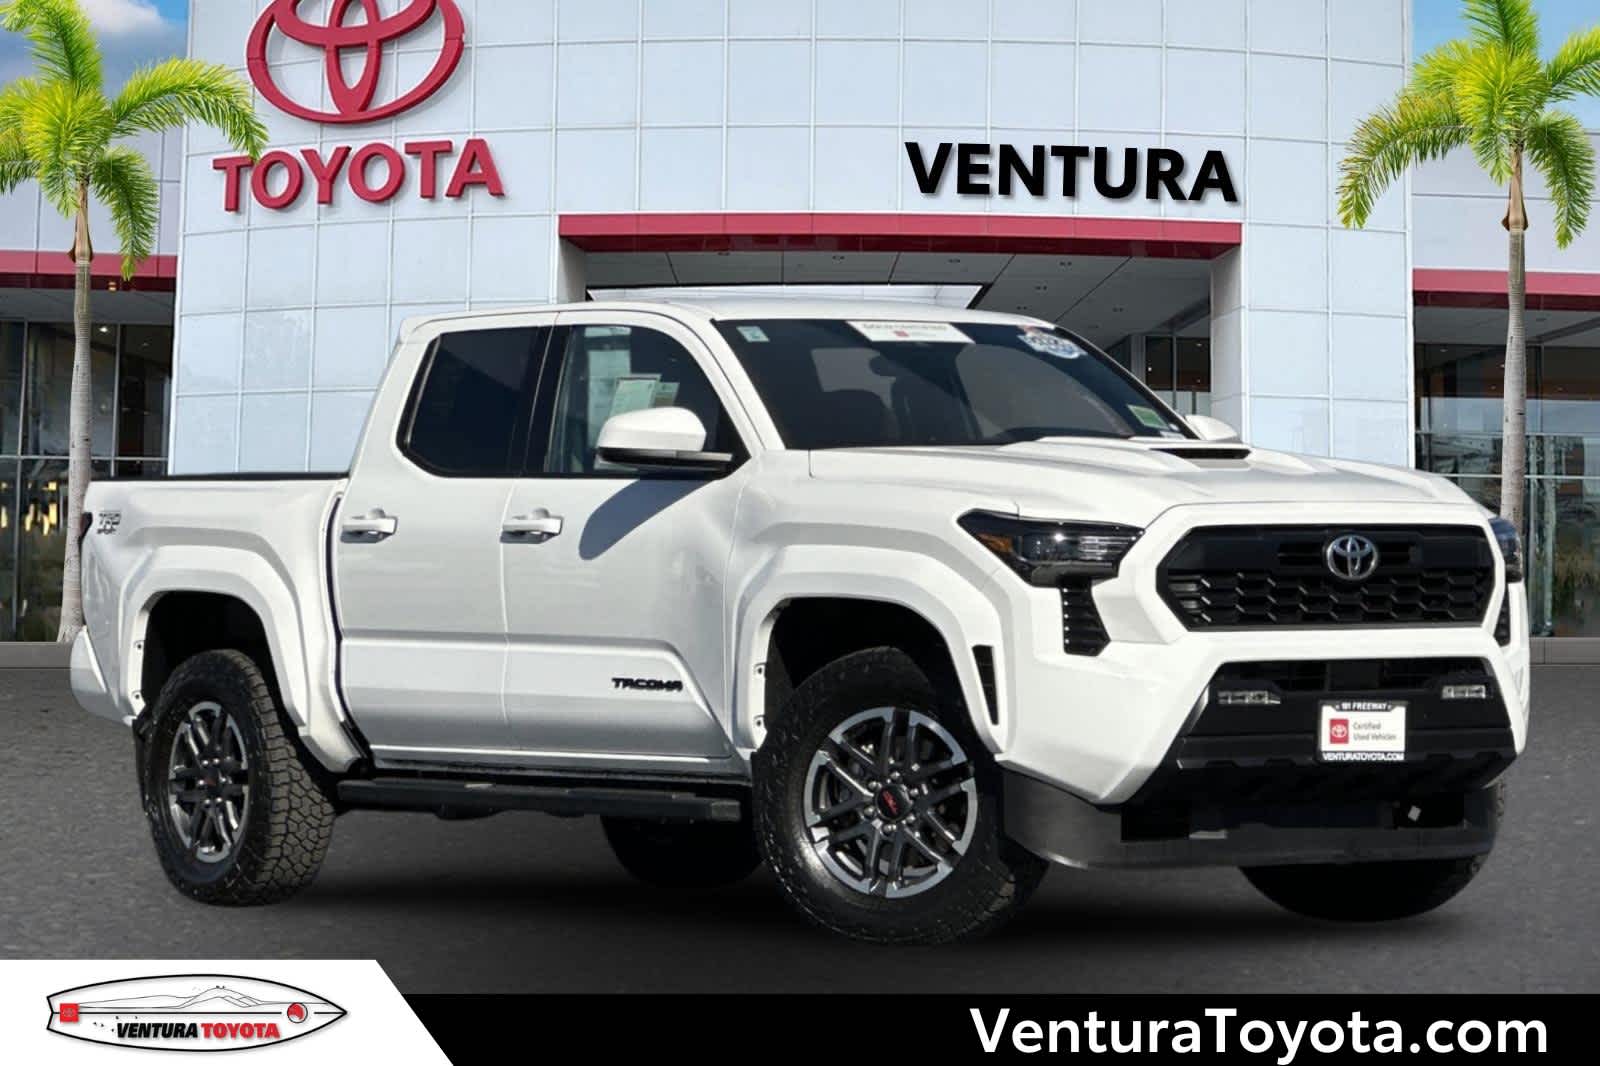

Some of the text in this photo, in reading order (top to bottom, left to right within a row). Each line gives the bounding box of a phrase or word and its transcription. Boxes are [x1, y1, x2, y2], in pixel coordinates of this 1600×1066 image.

[213, 138, 505, 212] TOYOTA
[904, 141, 1238, 203] VENTURA
[611, 677, 683, 692] TACOMA
[1353, 702, 1387, 710] FREEWAY
[1353, 721, 1381, 730] Certified
[1353, 733, 1370, 741] Used
[1323, 752, 1404, 761] VENTURATOYOTA.COM
